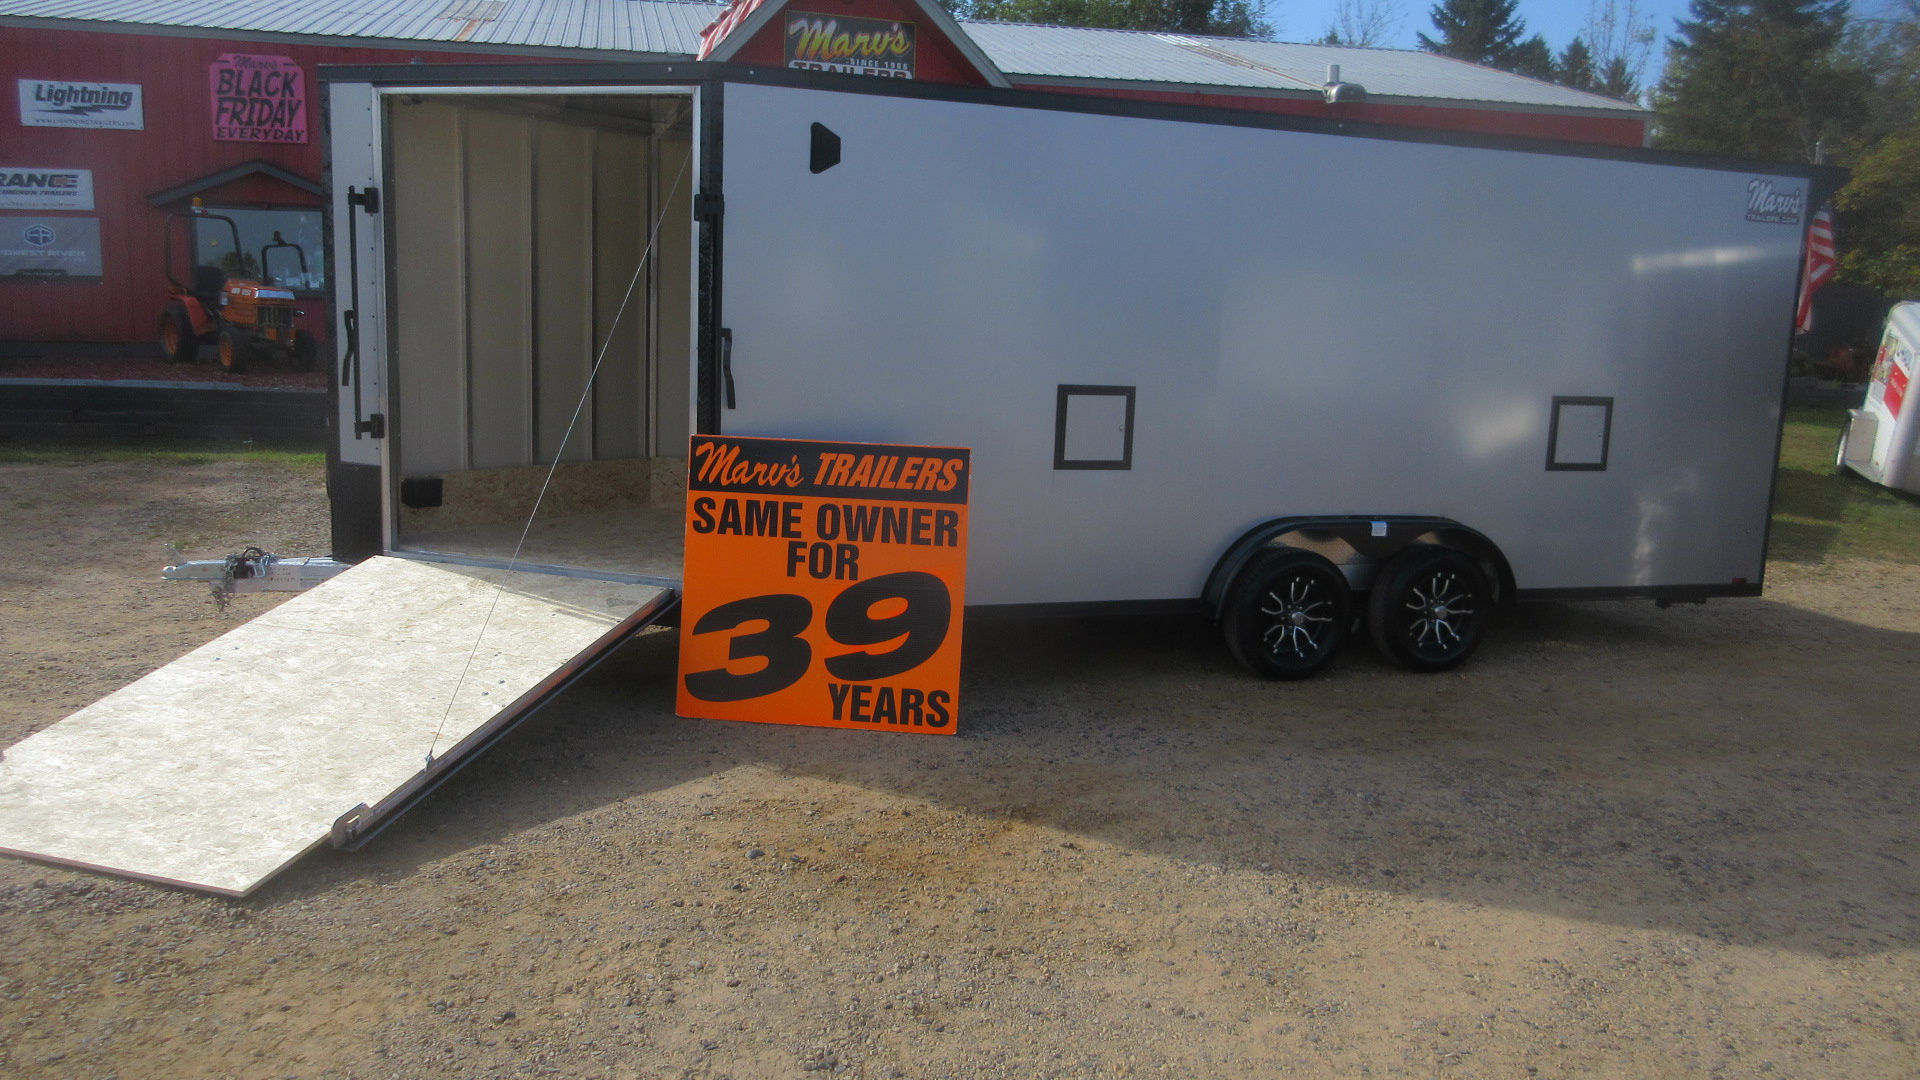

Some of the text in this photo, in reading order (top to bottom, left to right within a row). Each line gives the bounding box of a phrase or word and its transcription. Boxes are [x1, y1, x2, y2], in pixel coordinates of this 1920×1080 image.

[789, 18, 911, 61] Marv's
[849, 58, 908, 70] SINCE 1986
[35, 84, 133, 108] Lightning
[217, 69, 298, 98] BLACK
[216, 97, 302, 128] FRIDAY
[216, 126, 304, 140] EVERYDAY
[1748, 179, 1801, 214] Marv's
[696, 441, 963, 492] Marv's TRAILERS
[692, 497, 959, 547] SAME OWNER
[786, 541, 860, 581] FOR
[684, 571, 952, 703] 39
[827, 683, 950, 728] YEARS
